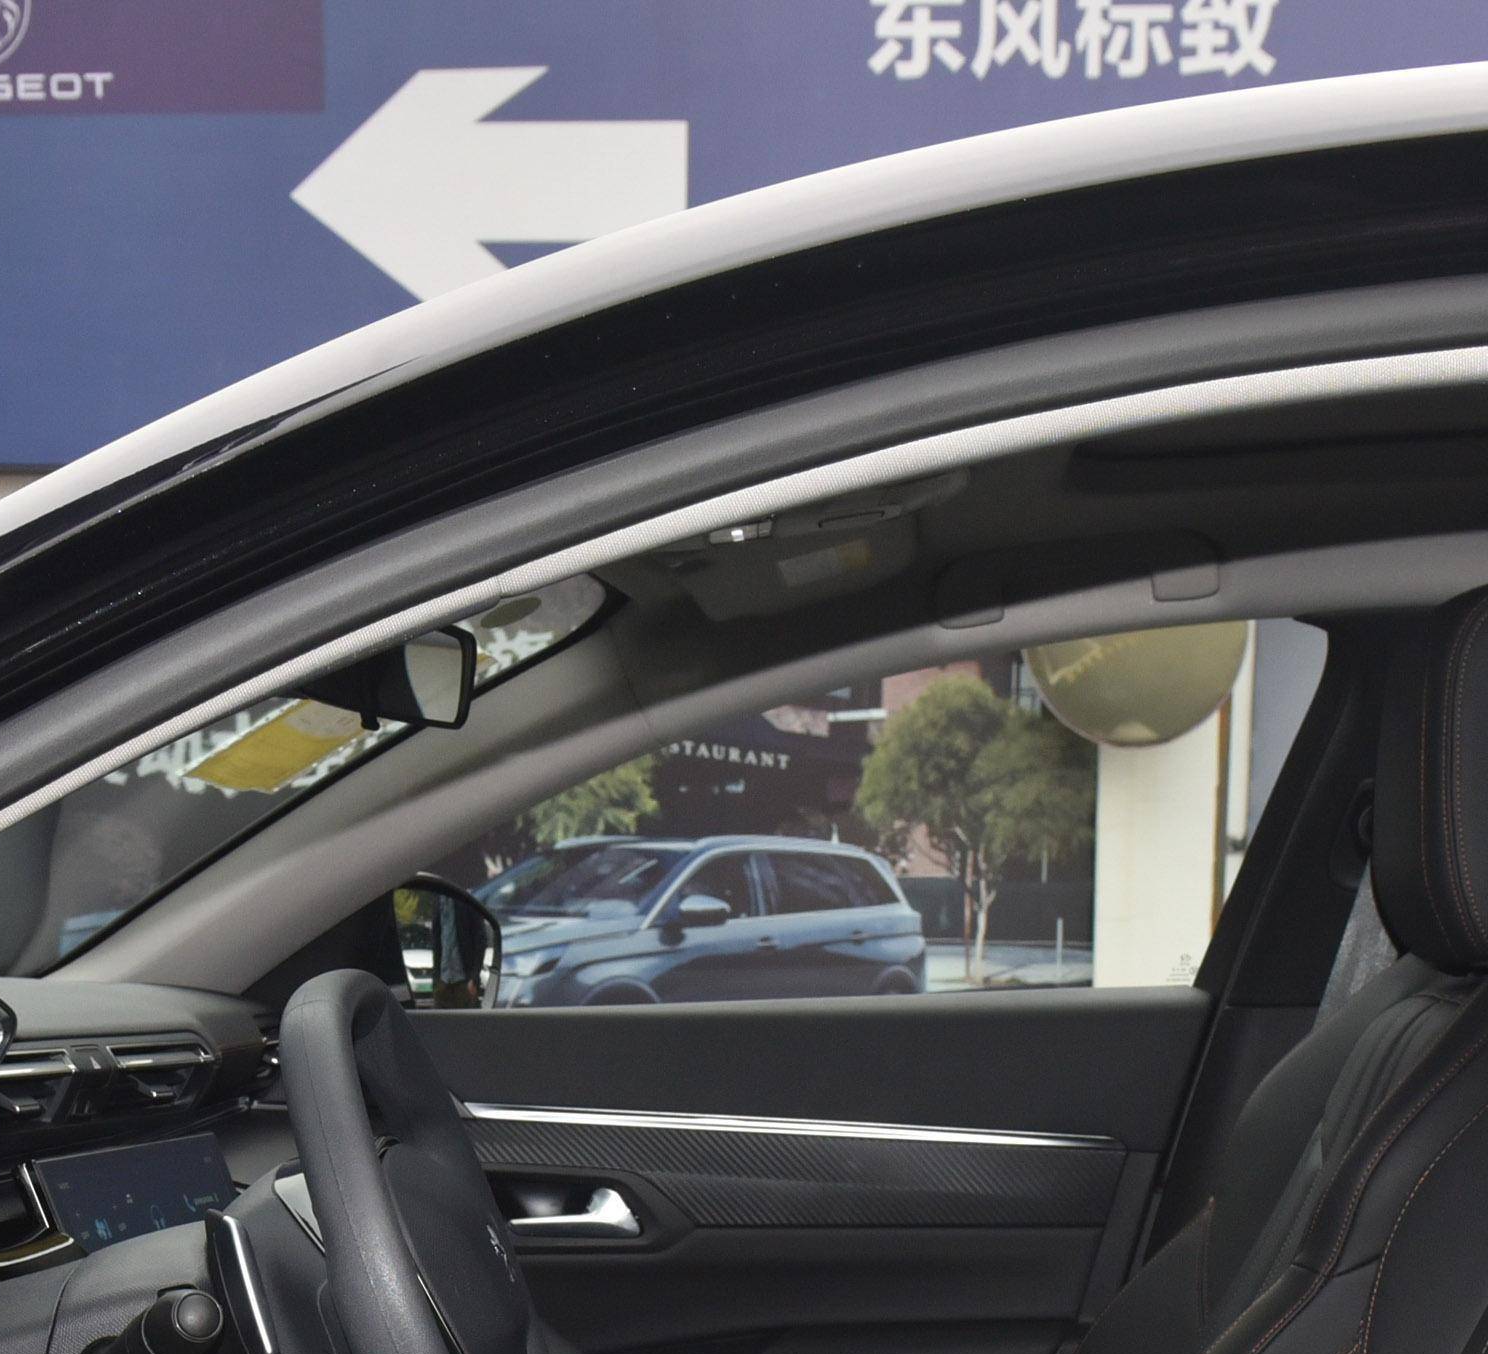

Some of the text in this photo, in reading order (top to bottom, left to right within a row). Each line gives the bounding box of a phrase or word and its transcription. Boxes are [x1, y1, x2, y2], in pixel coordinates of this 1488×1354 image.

[867, 0, 1278, 80] 东风标致
[662, 740, 790, 770] STAURANT
